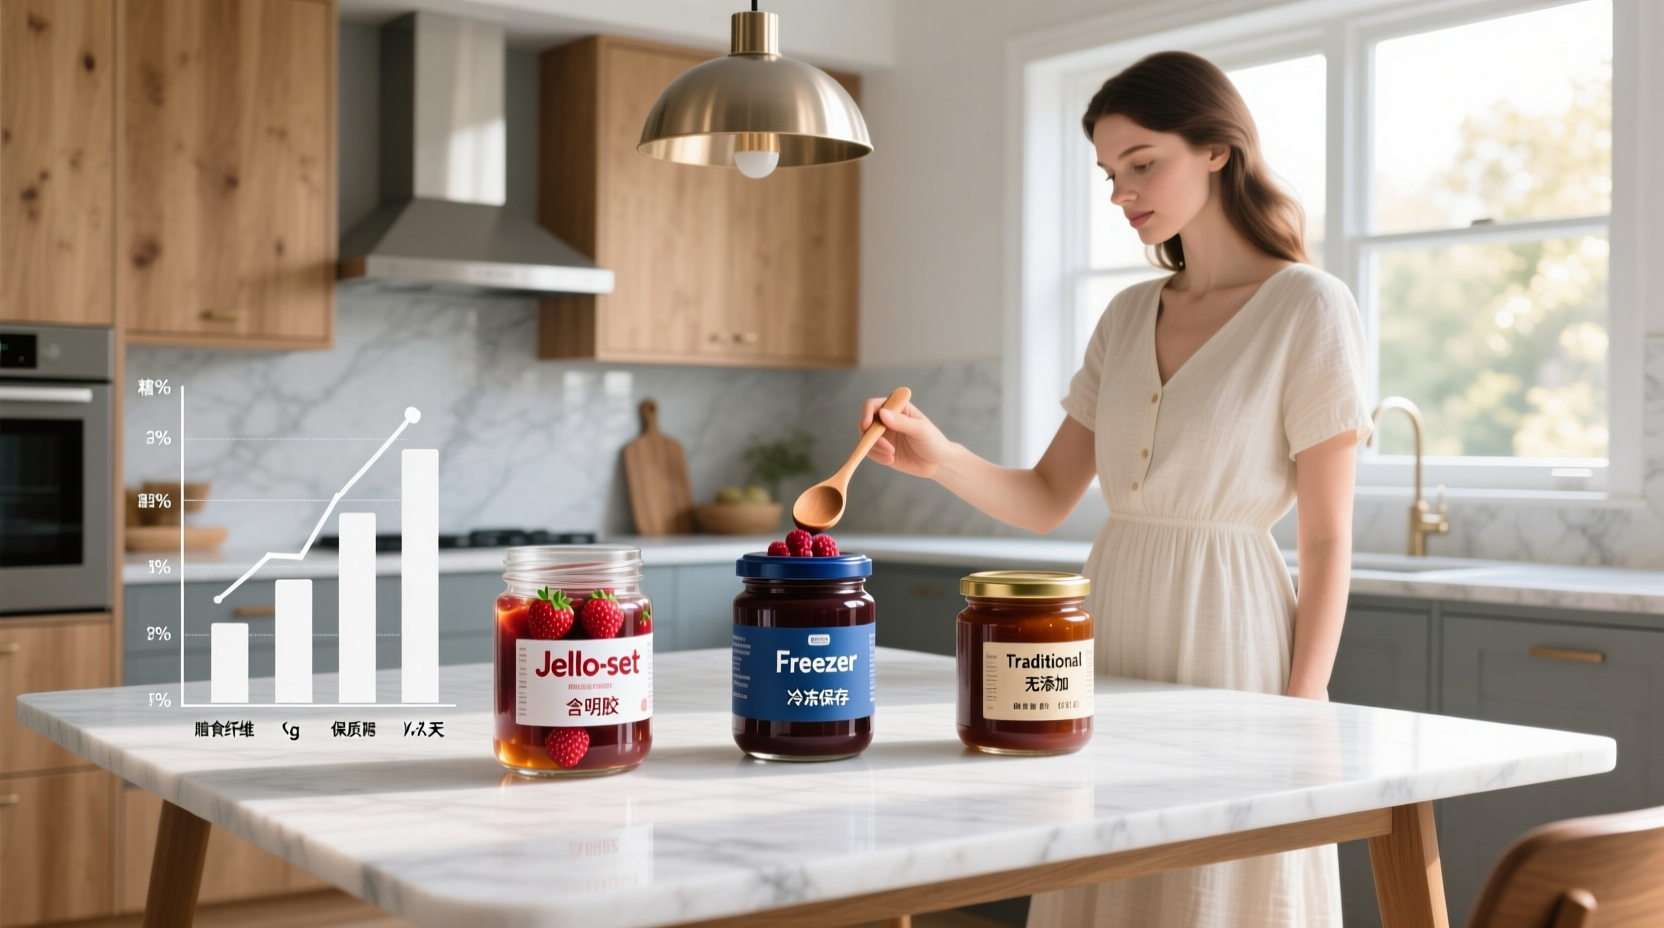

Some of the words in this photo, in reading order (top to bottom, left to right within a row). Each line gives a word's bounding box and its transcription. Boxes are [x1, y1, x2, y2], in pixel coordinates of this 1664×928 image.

[535, 649, 641, 678] Jello-set
[776, 649, 858, 674] Freezer
[1006, 651, 1082, 669] Traditional
[787, 687, 850, 707] 冷冻保存
